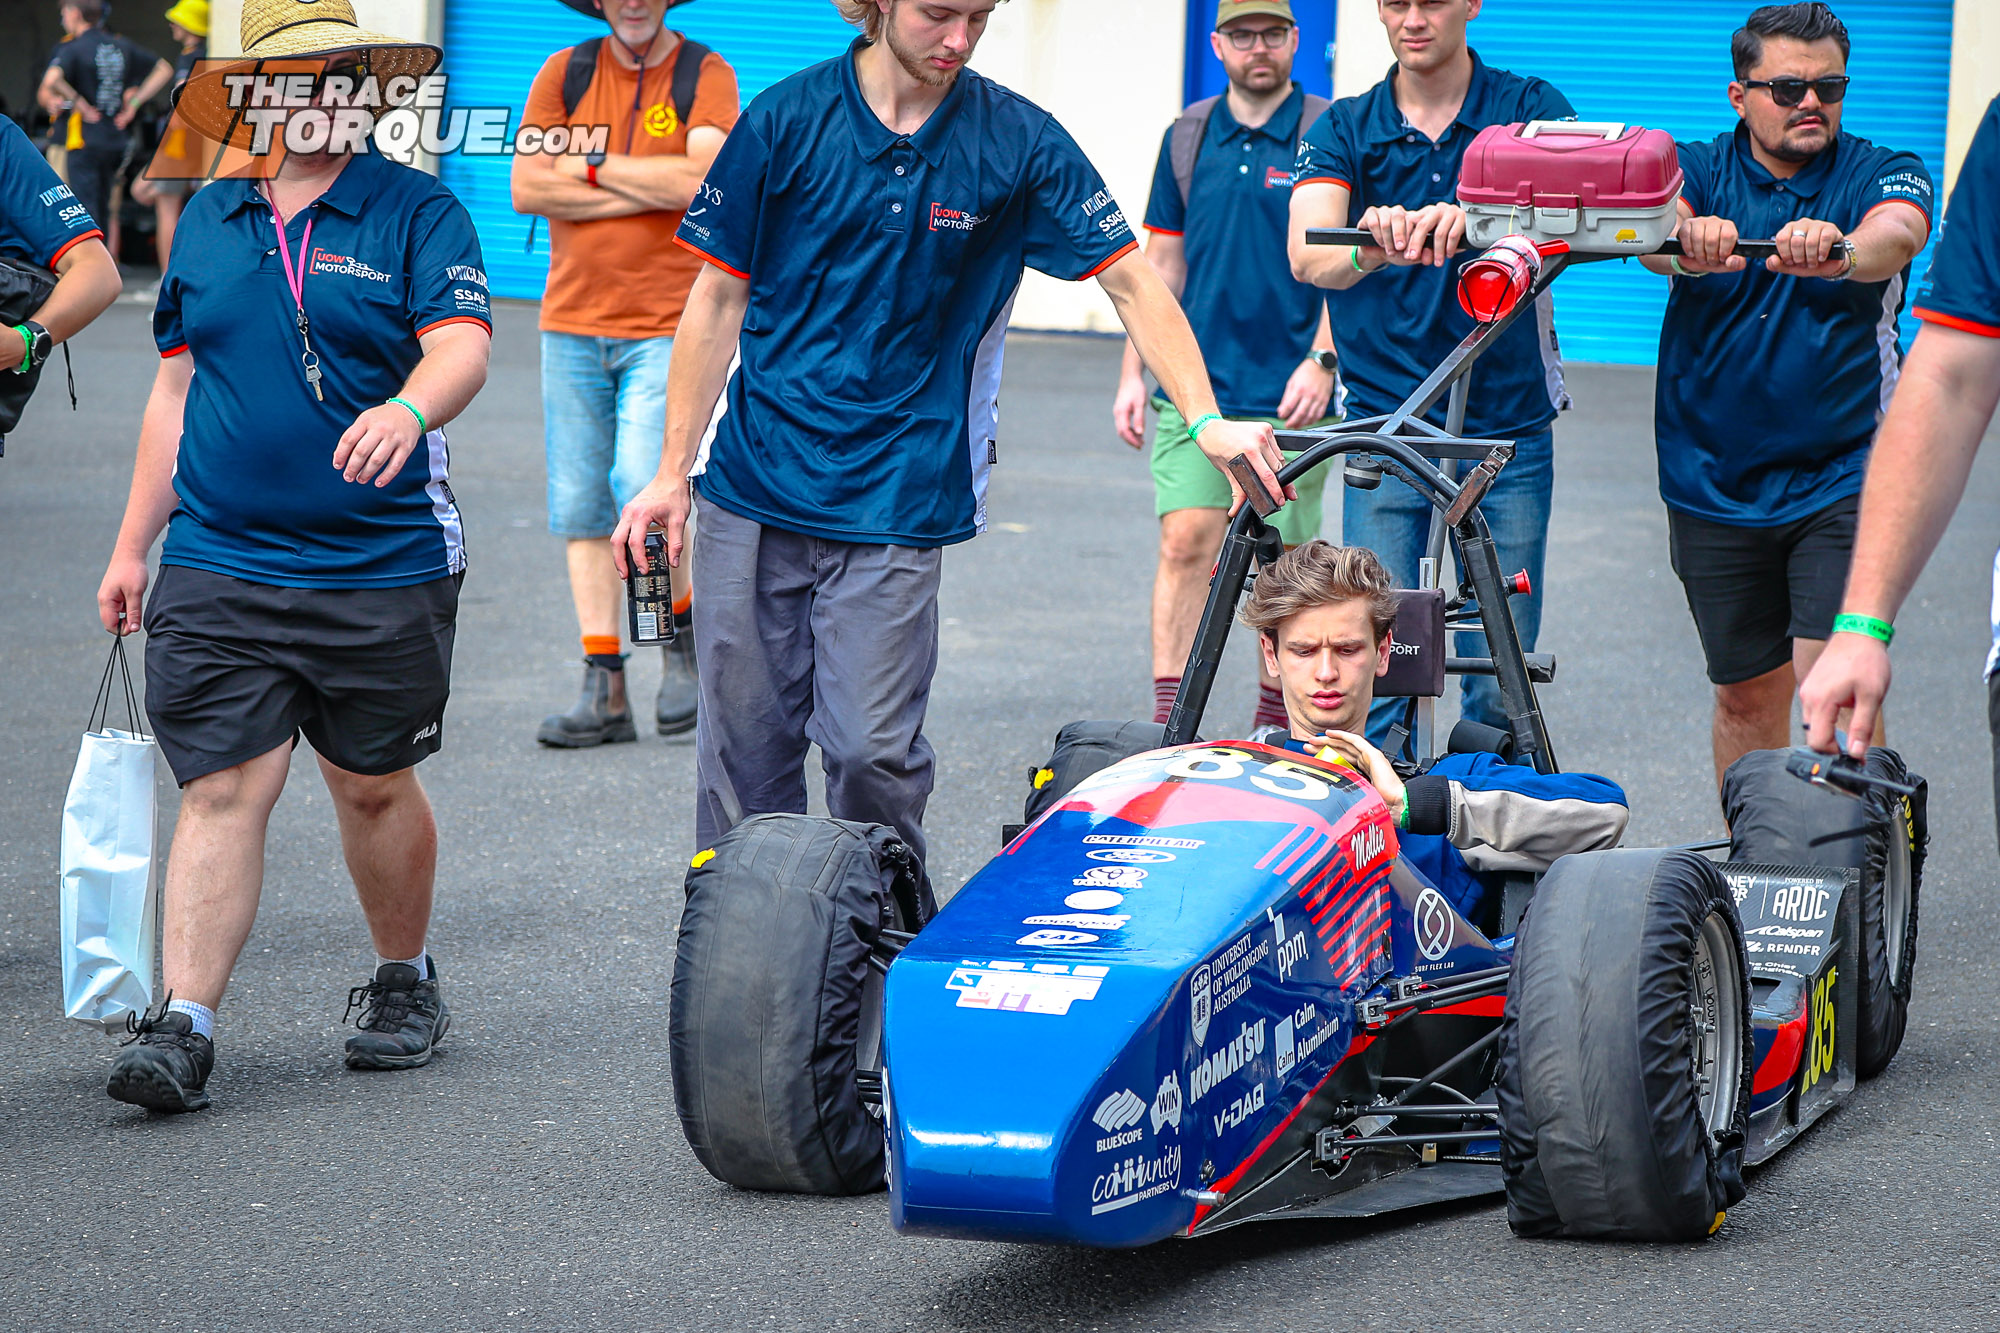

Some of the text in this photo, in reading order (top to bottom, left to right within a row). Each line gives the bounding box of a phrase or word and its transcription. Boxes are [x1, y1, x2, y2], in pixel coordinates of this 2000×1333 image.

[935, 207, 962, 219] UOW
[317, 252, 346, 264] UOW
[315, 261, 392, 283] MOTORSPORT
[453, 288, 487, 306] SSAF
[412, 721, 438, 745] FILA
[1084, 835, 1199, 848] CATERPILLAR
[1350, 822, 1386, 871] Mollie
[1784, 877, 1814, 885] POWERED
[1771, 885, 1831, 922] ARDC
[1211, 933, 1252, 977] UNIVERSITY
[1212, 939, 1269, 996] OF WOLLONGONG
[1414, 961, 1455, 973] SURF FLEX LAB
[1212, 973, 1252, 1016] AUSTRALIA
[1294, 1002, 1316, 1029] Calm
[1297, 1015, 1339, 1063] Aluminium
[1801, 965, 1837, 1096] 85
[1190, 1017, 1266, 1105] KOMATSU
[1277, 1050, 1294, 1071] Calm
[1158, 1087, 1179, 1115] WIN
[1213, 1082, 1265, 1138] V-DAQ
[1138, 1181, 1171, 1202] PARTNERS
